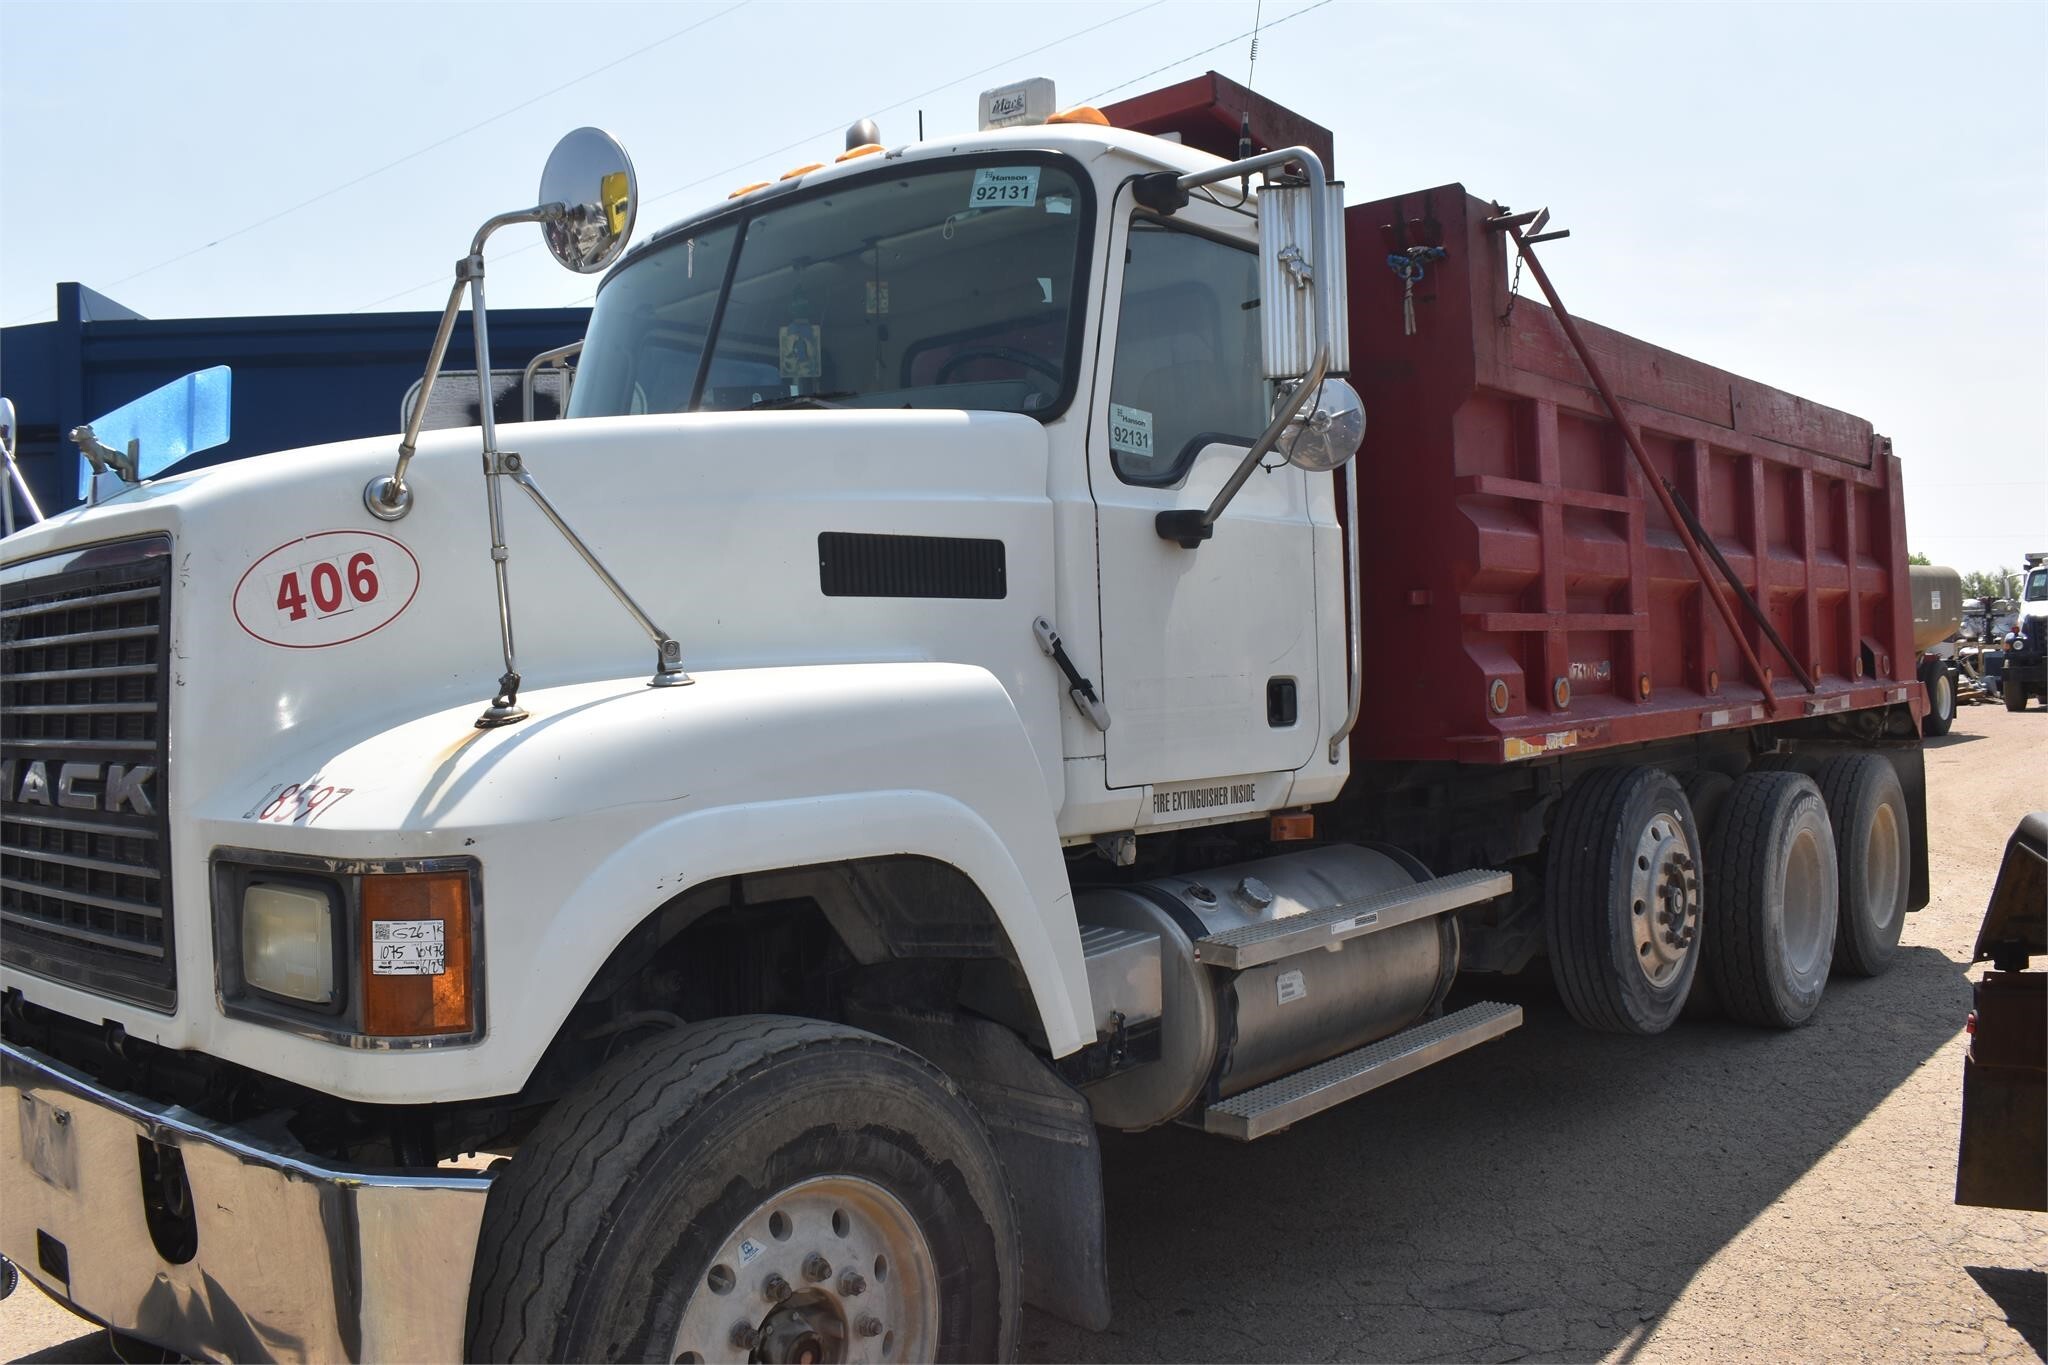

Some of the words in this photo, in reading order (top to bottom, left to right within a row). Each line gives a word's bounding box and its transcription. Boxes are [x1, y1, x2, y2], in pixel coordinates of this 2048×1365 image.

[976, 185, 1030, 201] 92131
[1122, 415, 1146, 428] Hanson
[1114, 426, 1149, 449] 92131
[277, 552, 380, 622] 406
[1153, 792, 1170, 814] FIRE
[1172, 786, 1228, 811] EXTINGUISHER
[1231, 783, 1256, 804] INSIDE
[380, 945, 406, 960] 1075
